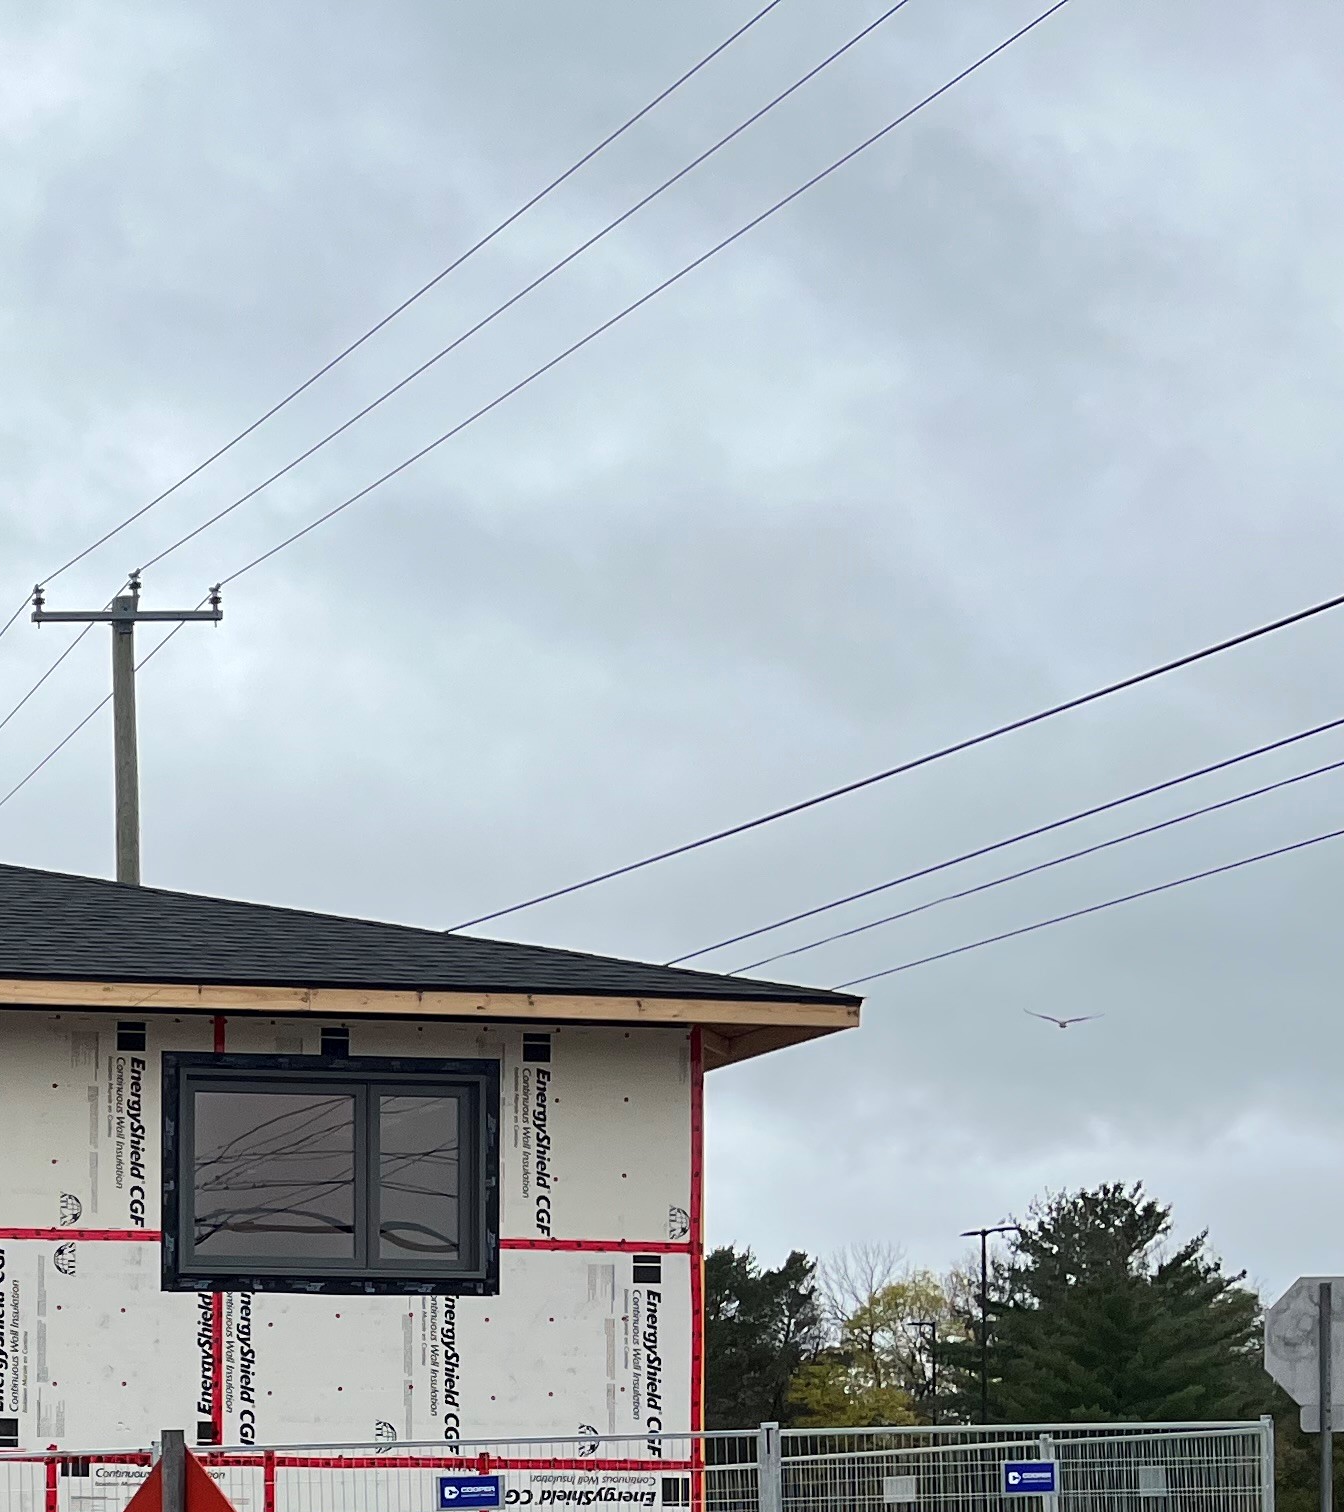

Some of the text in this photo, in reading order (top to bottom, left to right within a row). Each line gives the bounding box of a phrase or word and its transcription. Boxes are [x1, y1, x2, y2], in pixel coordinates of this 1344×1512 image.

[115, 1056, 126, 1189] Continuous Wall Insulation
[127, 1056, 146, 1228] EnergyShield CGF
[522, 1068, 532, 1199] Continuous Wall Insulation
[533, 1067, 551, 1237] EnergyShield CGF
[668, 1204, 677, 1240] ATLAS
[632, 1289, 642, 1345] Continuous
[9, 1279, 20, 1413] Continuous Wall Insulation
[643, 1290, 662, 1414] EnergyShield
[226, 1364, 235, 1414] Insulation
[430, 1368, 439, 1416] Insulation
[632, 1372, 642, 1420] Insulation
[541, 1487, 656, 1507] EnergyShield
[602, 1475, 656, 1486] Continuous
